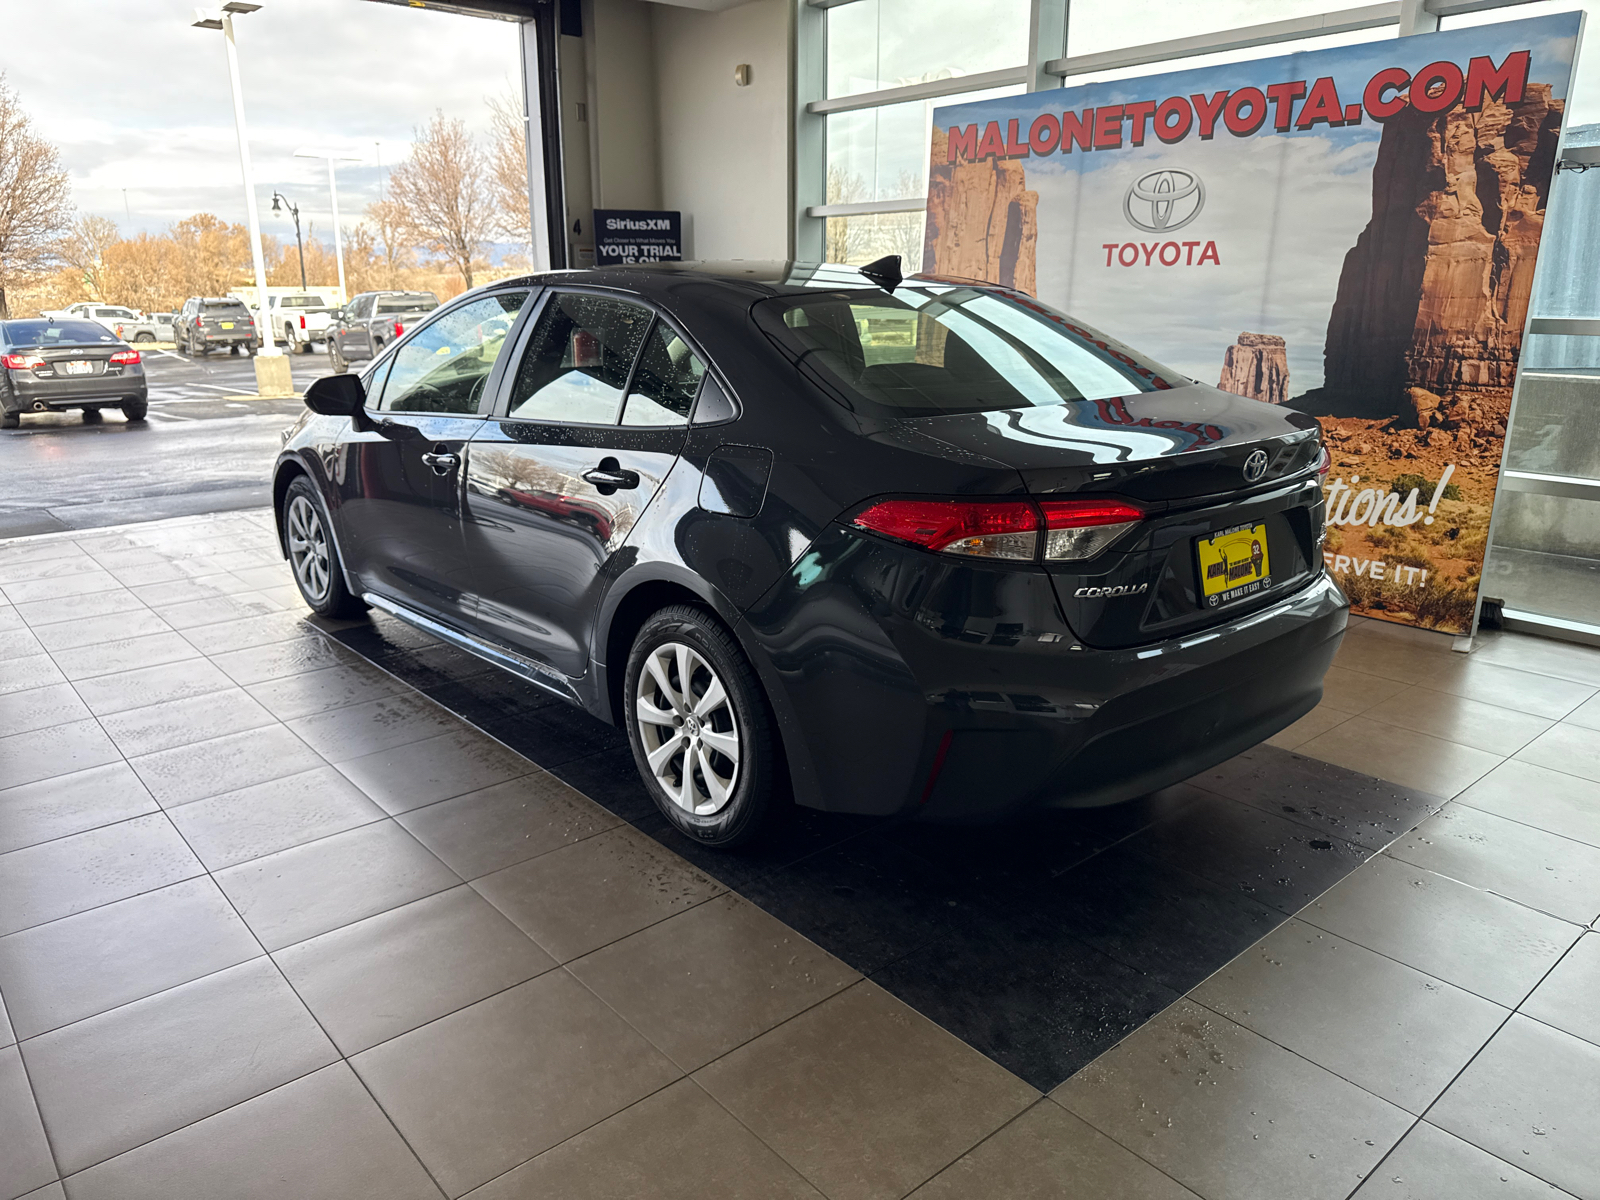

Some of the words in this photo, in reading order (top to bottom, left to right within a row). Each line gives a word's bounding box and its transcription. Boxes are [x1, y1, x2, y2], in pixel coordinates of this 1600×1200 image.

[947, 49, 1532, 165] MALONETOYOTA.COM
[573, 219, 581, 235] 4
[606, 218, 671, 231] SiriusXM
[666, 237, 676, 245] You
[599, 245, 639, 257] YOUR
[641, 245, 681, 257] TRIAL
[1102, 240, 1221, 267] TOYOTA
[1252, 544, 1260, 555] 32
[1206, 561, 1225, 580] KARL
[1394, 564, 1427, 588] IT!
[1074, 583, 1148, 598] COROLLA
[1222, 592, 1230, 602] WE
[1230, 586, 1244, 599] MAKE
[1248, 581, 1260, 593] EASY
